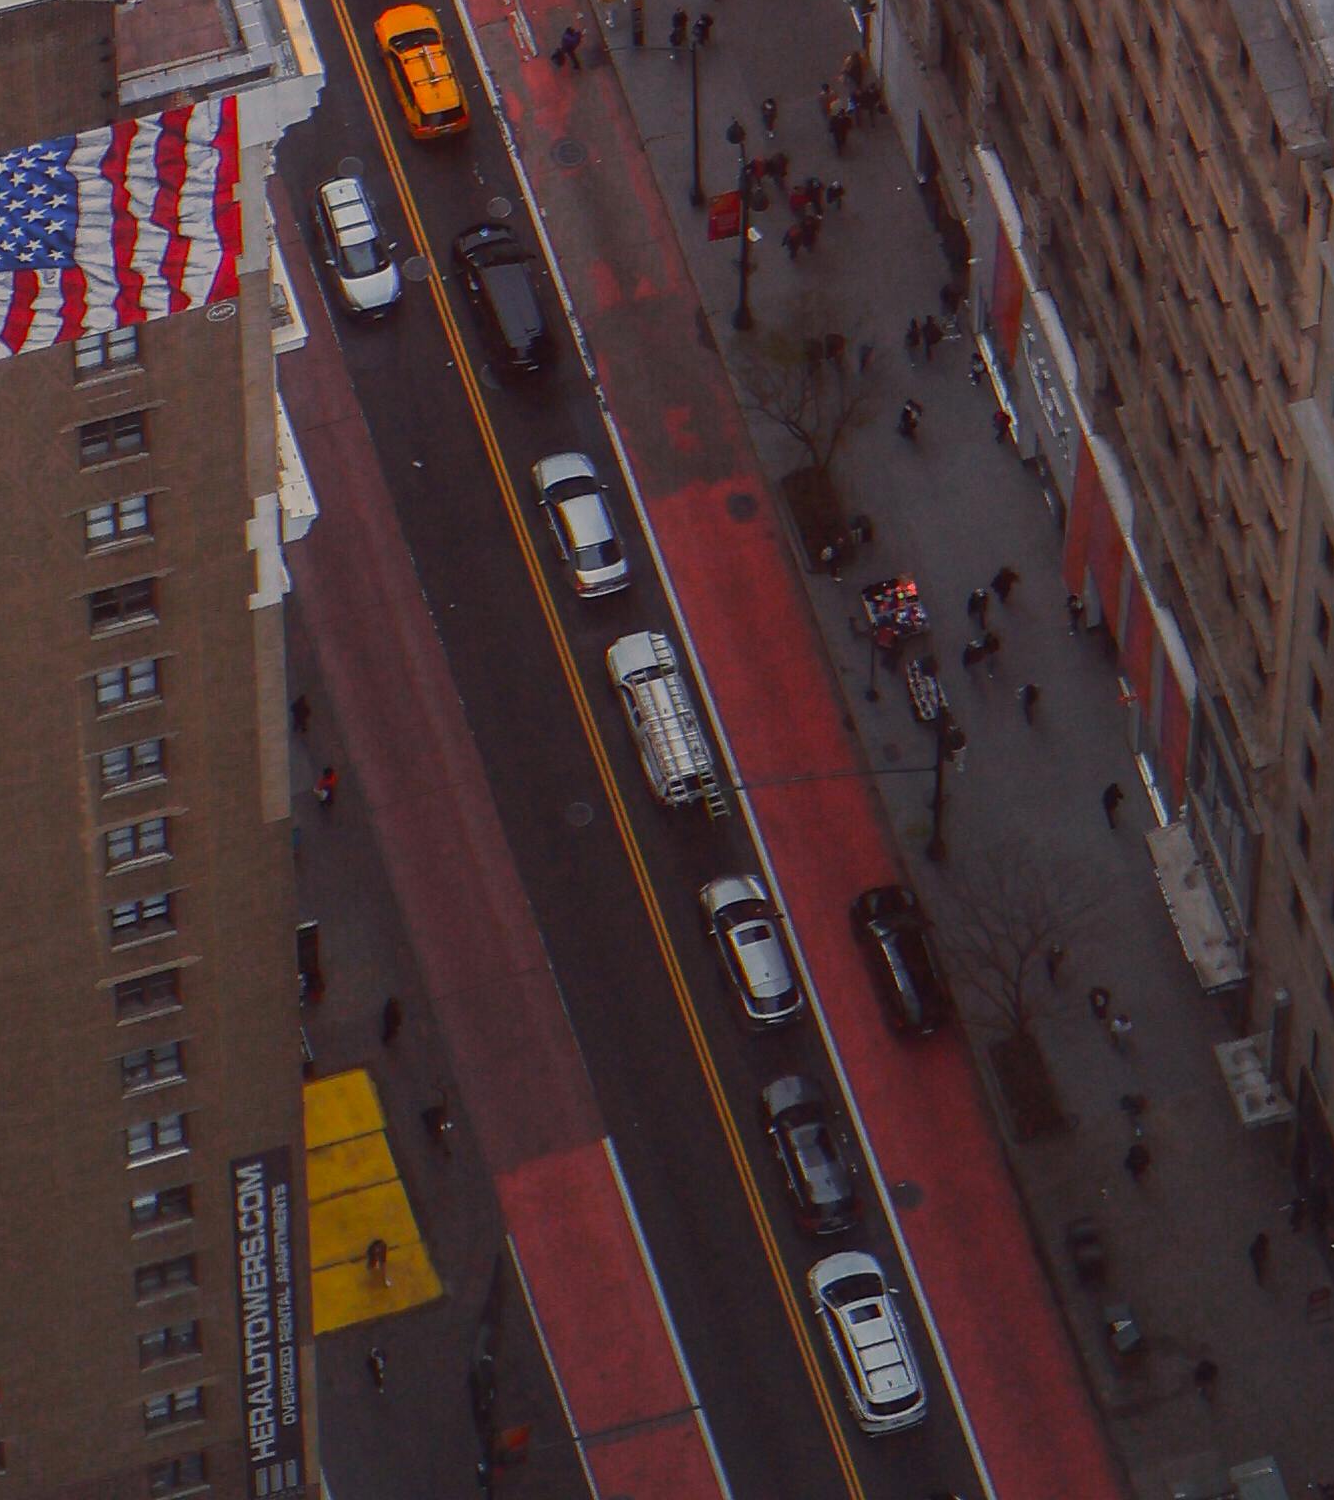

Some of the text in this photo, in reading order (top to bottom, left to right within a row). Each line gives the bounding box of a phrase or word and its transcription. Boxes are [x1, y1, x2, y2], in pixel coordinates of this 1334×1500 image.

[236, 1163, 277, 1462] HERALDTOWERS.COM
[276, 1290, 293, 1343] RENTAL
[278, 1345, 297, 1426] OVERSIZED
